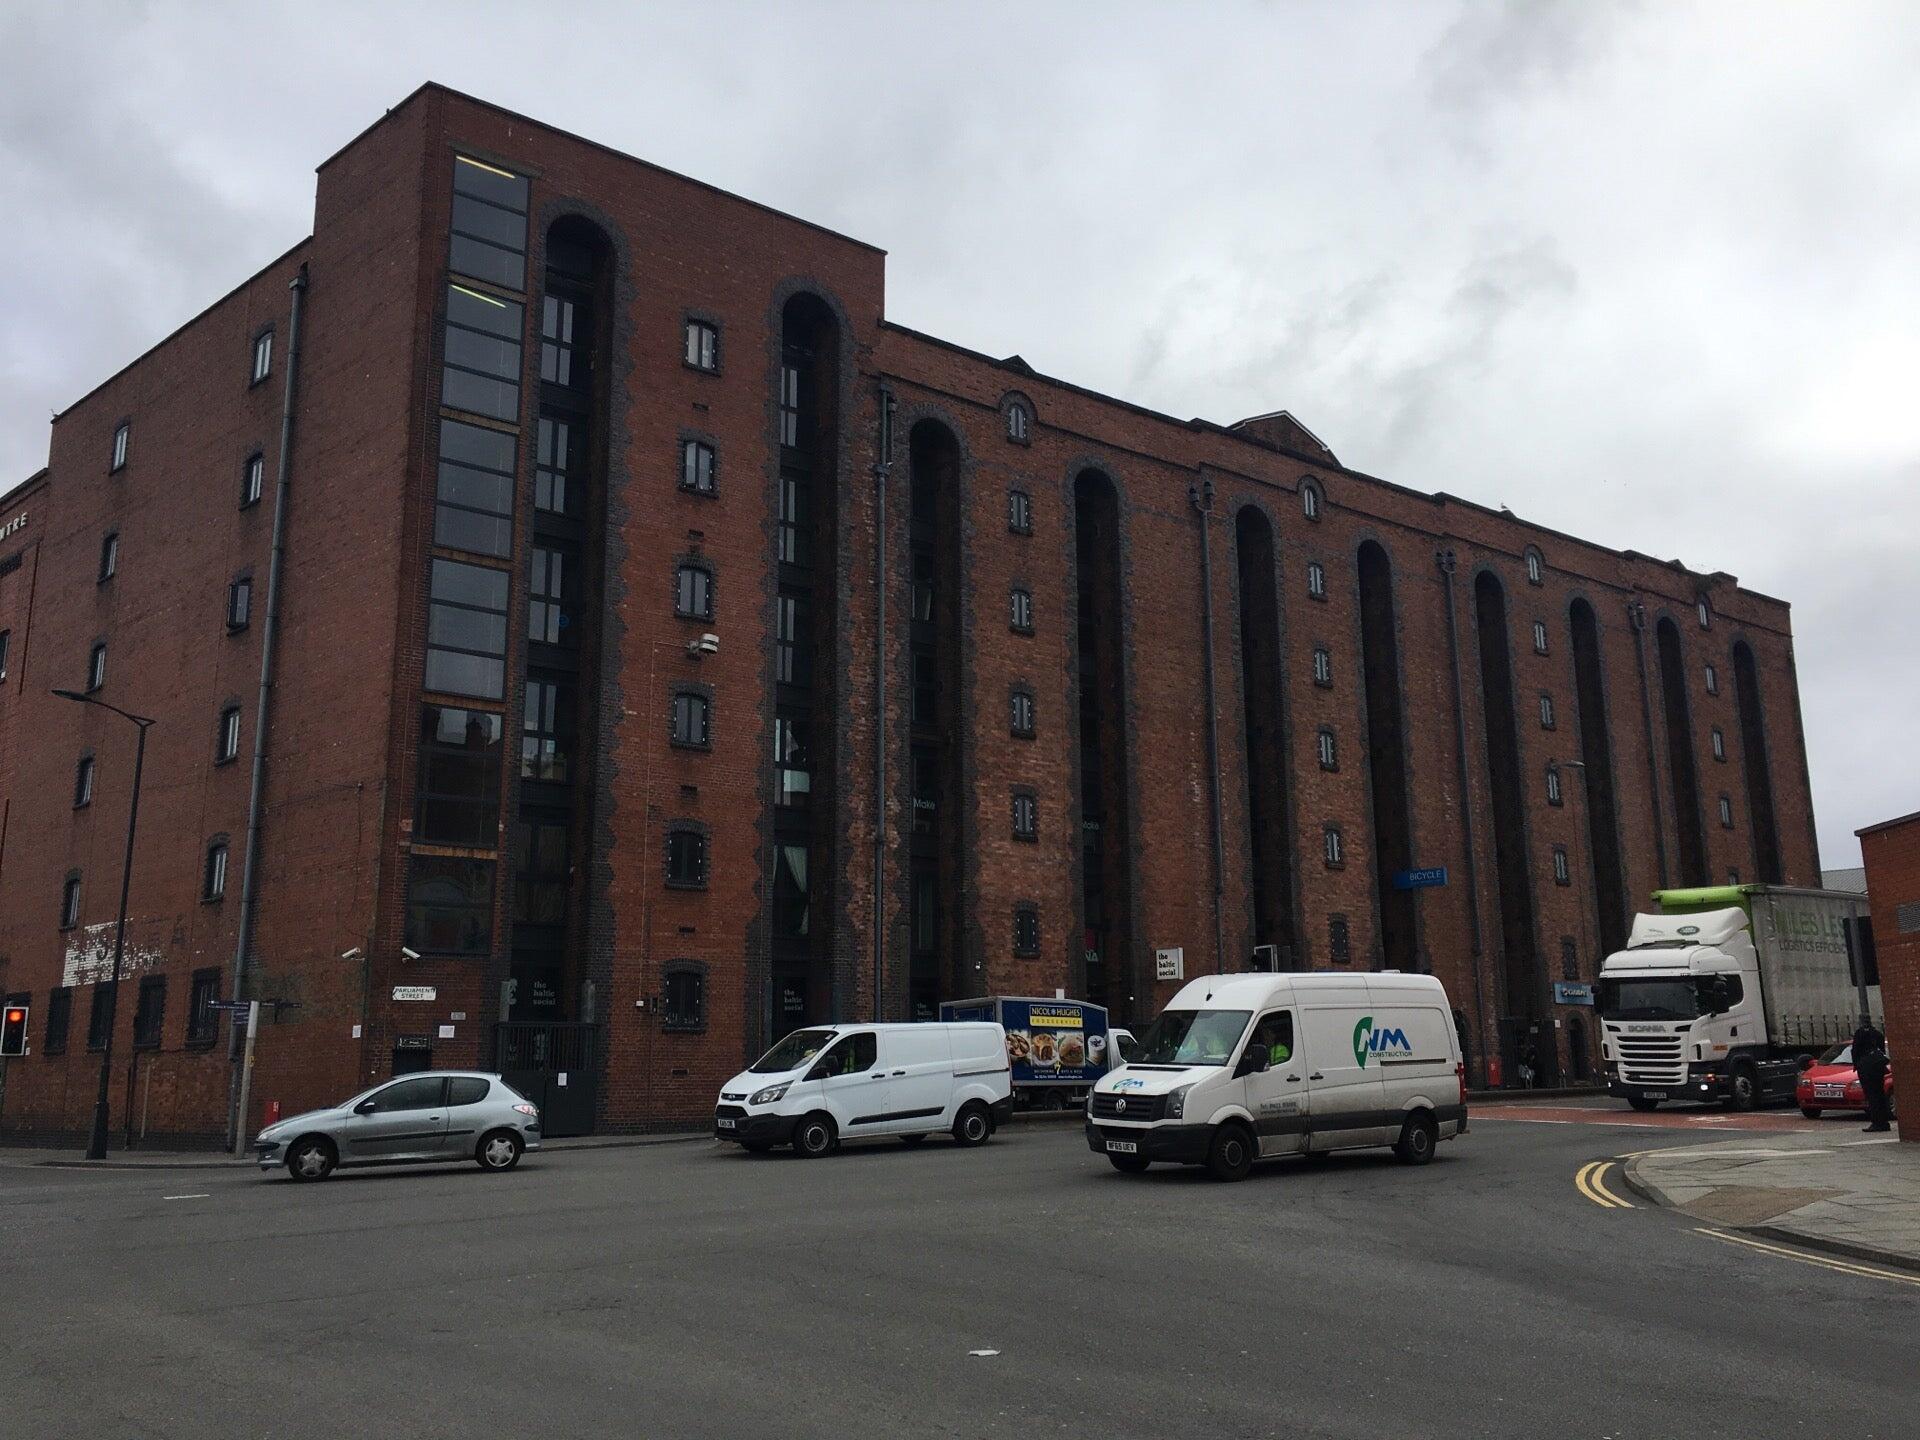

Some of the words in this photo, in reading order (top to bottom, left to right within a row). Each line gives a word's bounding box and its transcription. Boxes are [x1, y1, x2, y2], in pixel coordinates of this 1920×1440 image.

[1409, 870, 1441, 881] BICYCLE
[534, 981, 546, 989] the
[533, 989, 555, 997] baltic
[1031, 1007, 1050, 1016] NICOL
[1056, 1008, 1081, 1017] HUGHES
[1628, 1025, 1666, 1033] SCANIA
